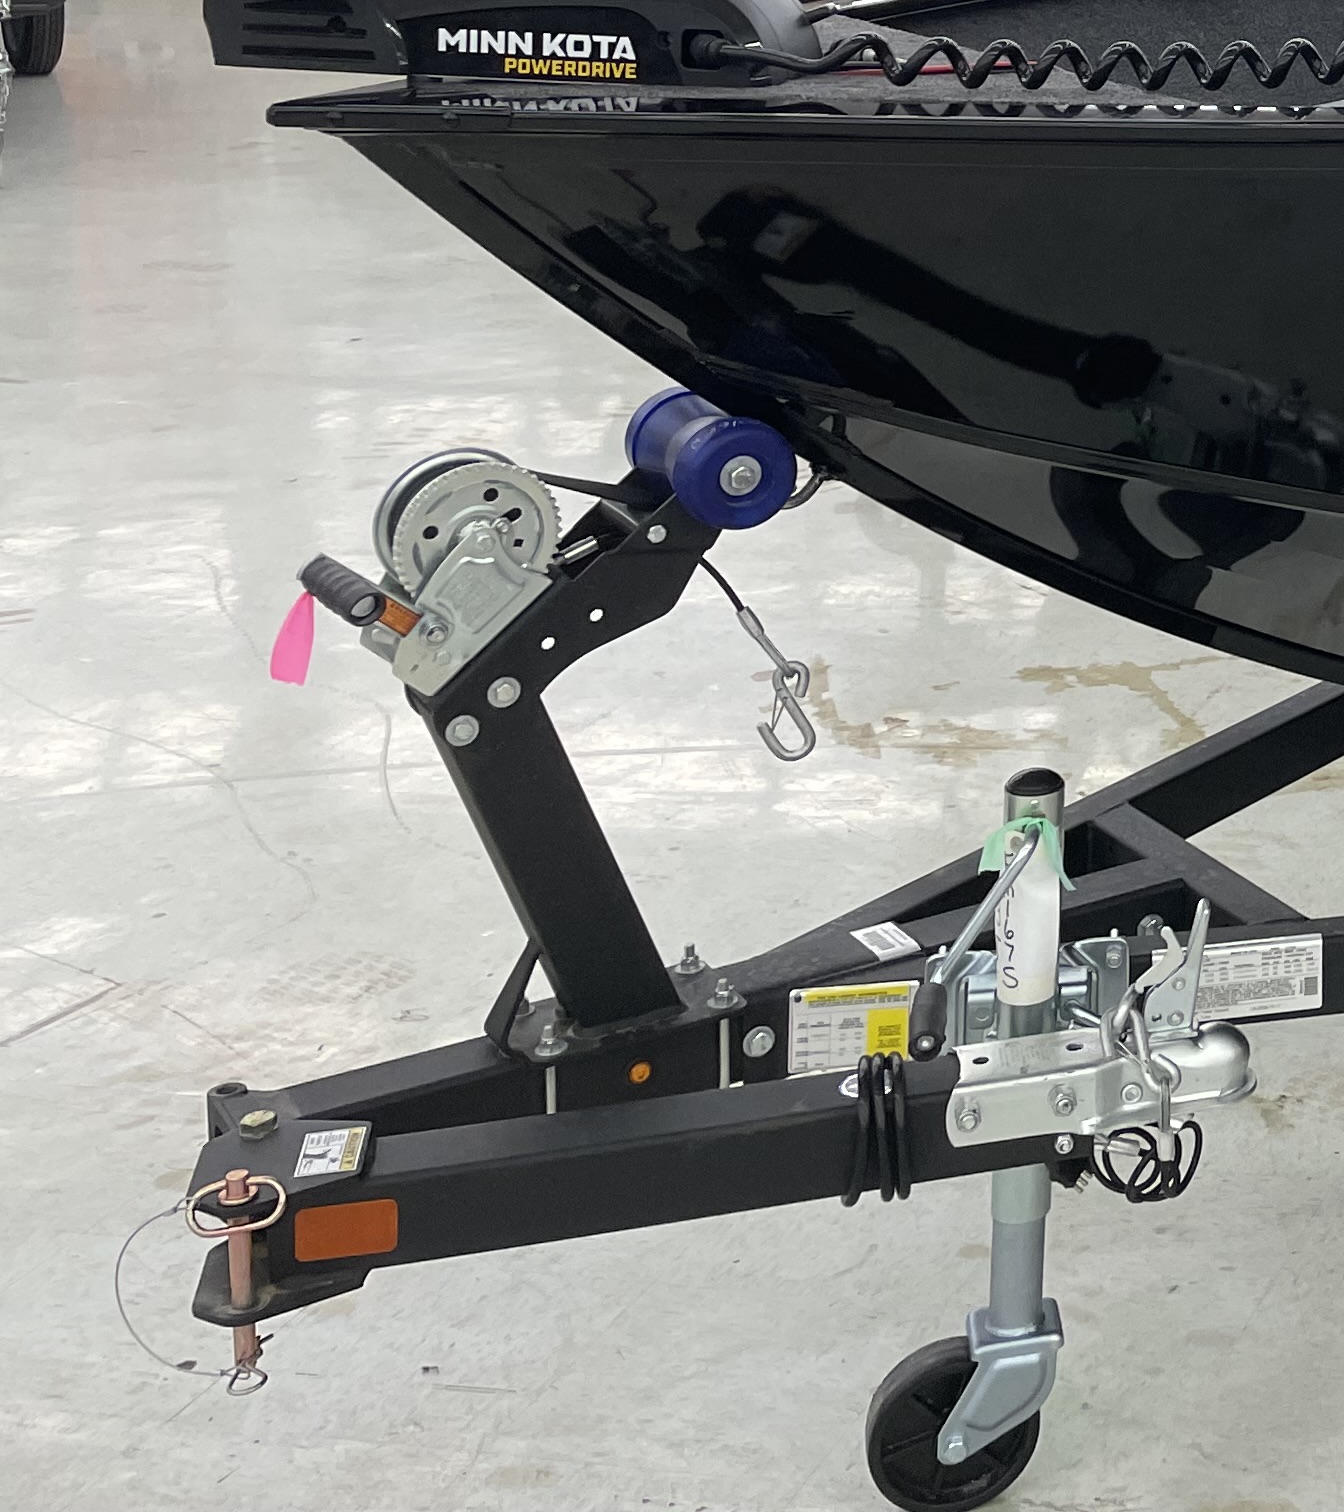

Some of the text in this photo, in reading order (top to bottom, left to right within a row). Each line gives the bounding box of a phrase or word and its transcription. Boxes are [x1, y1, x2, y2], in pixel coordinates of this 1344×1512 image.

[437, 27, 637, 61] MINN KOTA
[503, 57, 638, 80] POWERDRIVE
